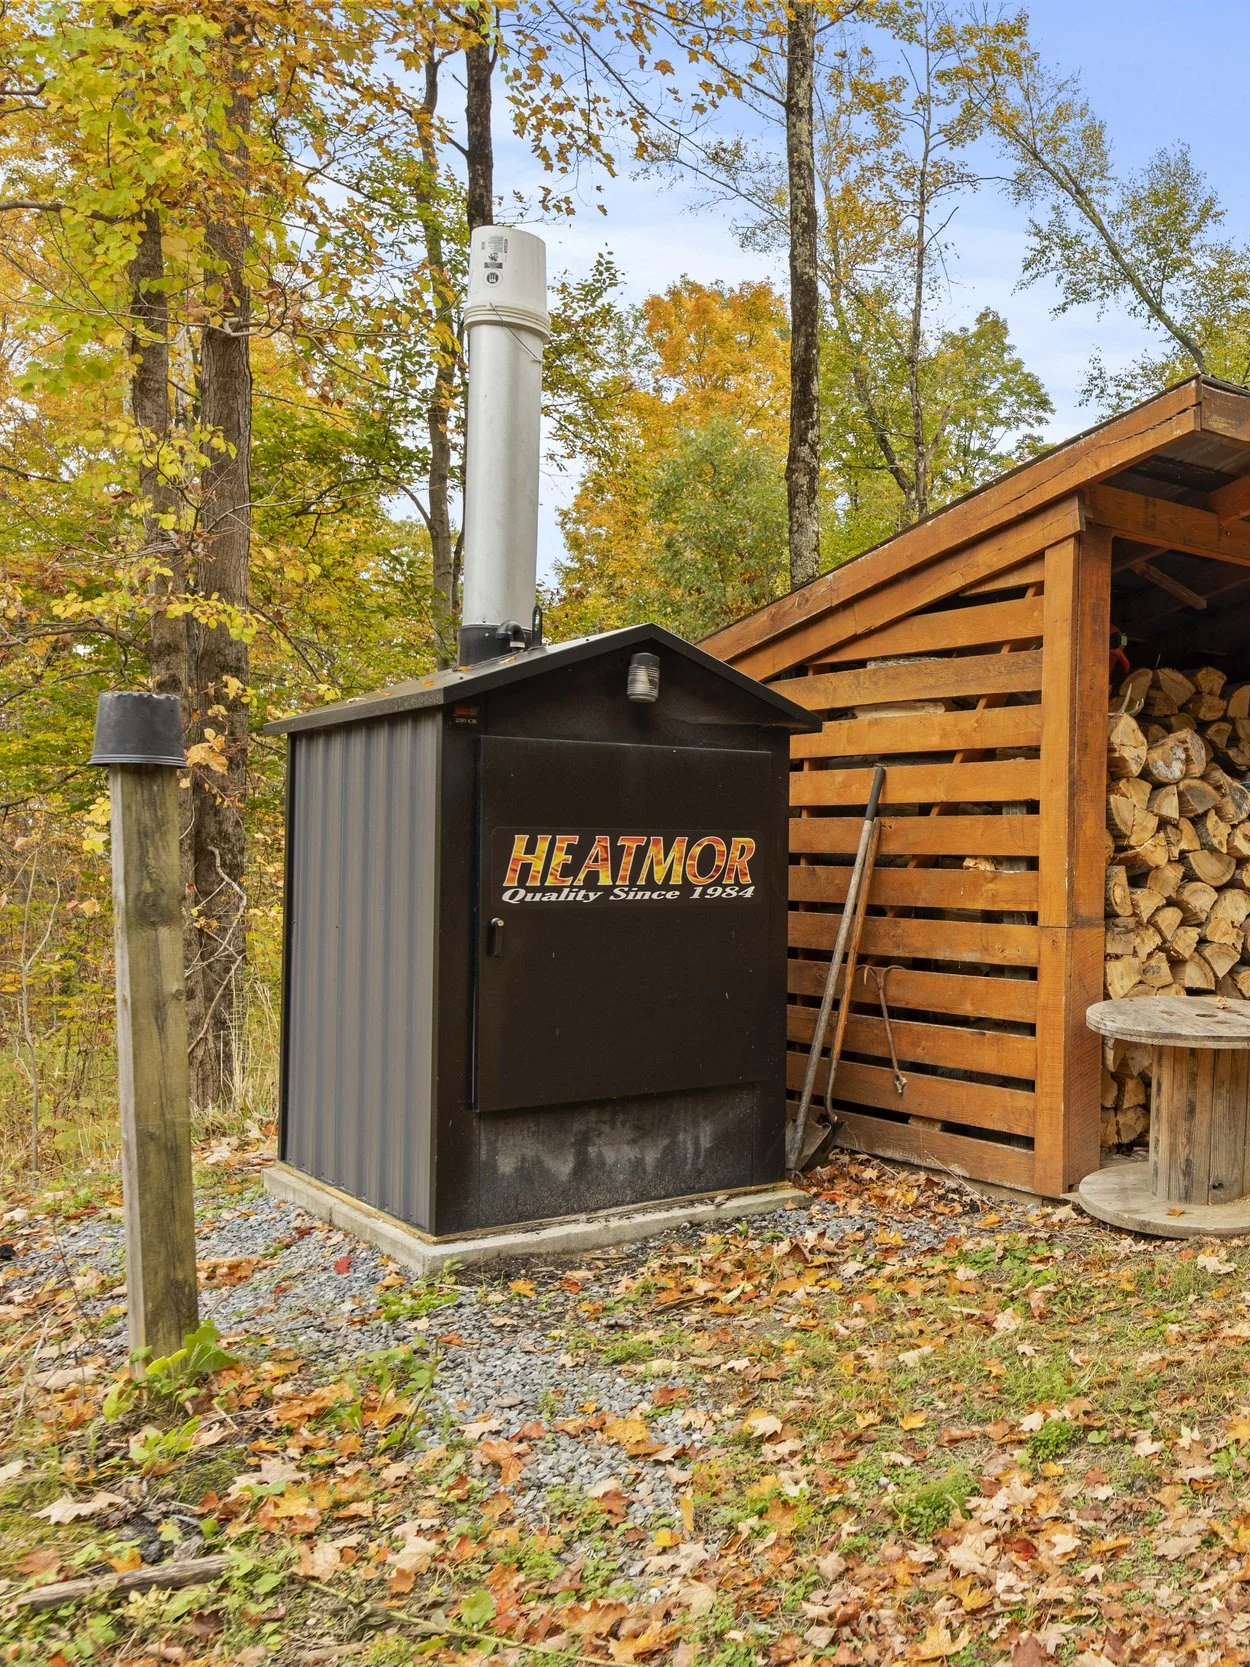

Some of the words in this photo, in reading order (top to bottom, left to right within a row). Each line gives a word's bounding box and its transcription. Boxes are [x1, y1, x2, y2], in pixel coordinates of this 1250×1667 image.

[503, 835, 756, 886] HEATMOR
[502, 887, 603, 904] Quality
[609, 886, 680, 900] Since
[689, 885, 756, 900] 1984
